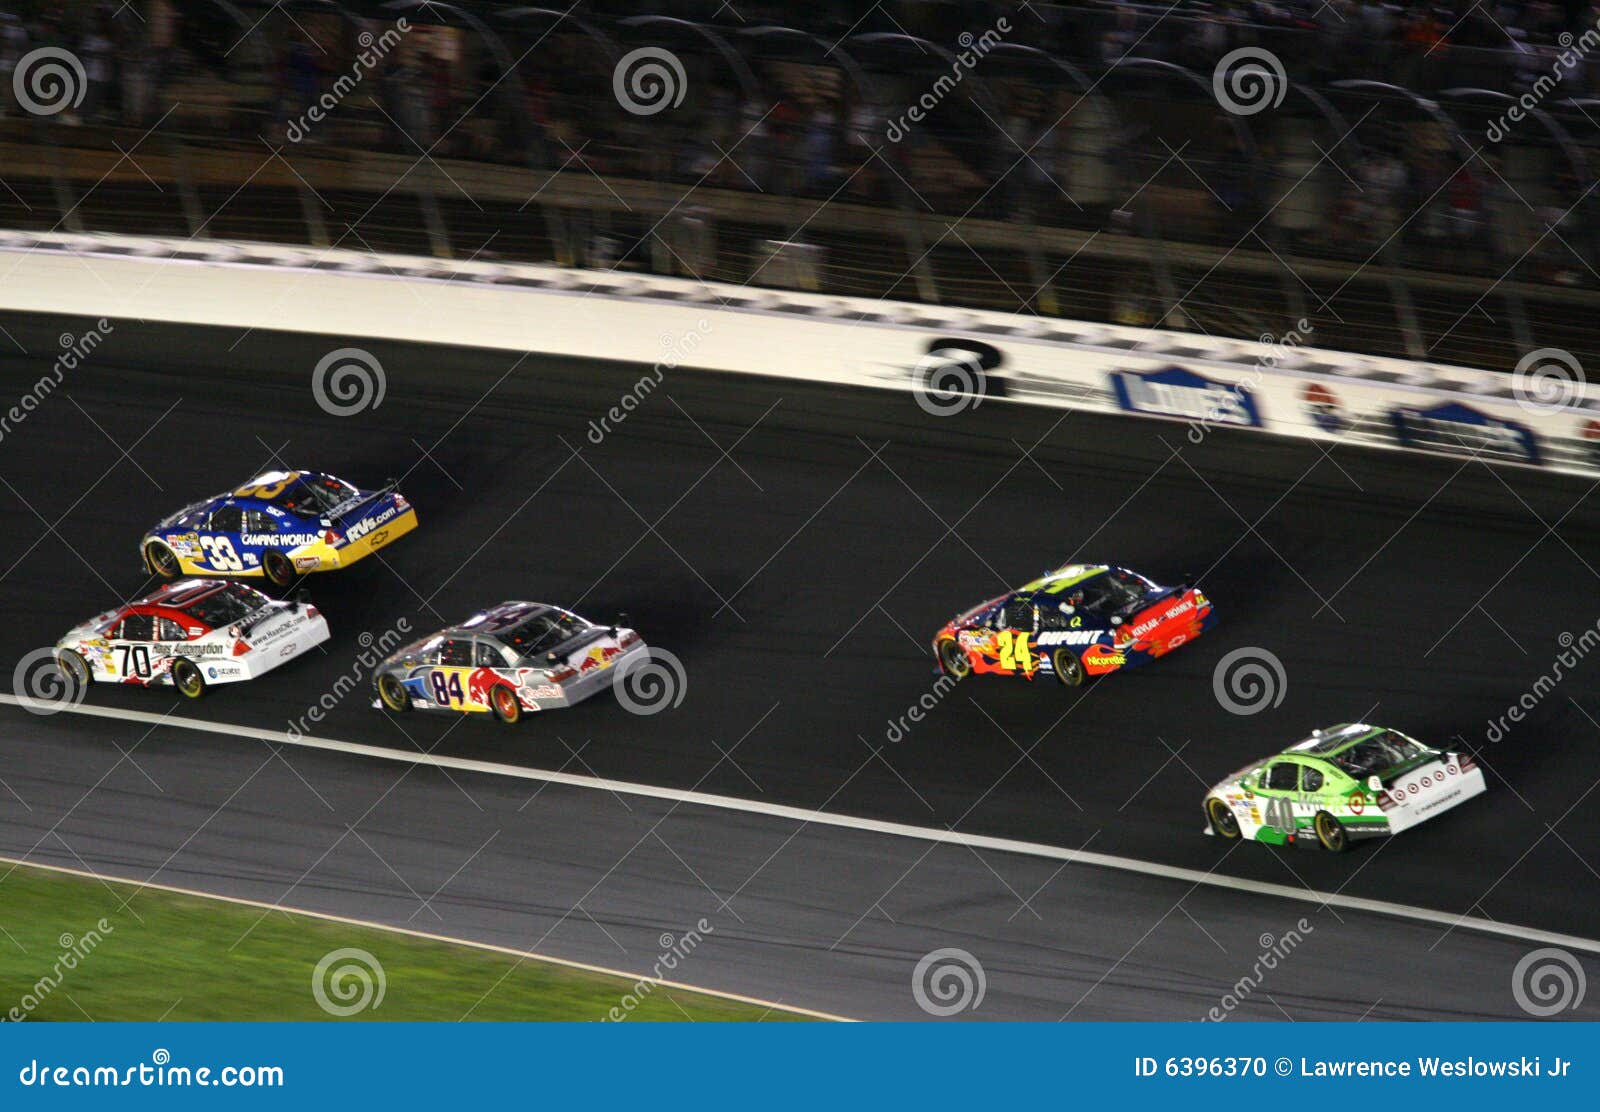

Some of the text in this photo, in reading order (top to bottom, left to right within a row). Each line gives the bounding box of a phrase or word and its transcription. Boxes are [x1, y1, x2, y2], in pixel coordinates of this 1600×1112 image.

[240, 532, 313, 547] CAMPING WORLD
[345, 506, 397, 544] RVs.com
[200, 535, 245, 572] 33
[115, 645, 152, 678] 70
[173, 642, 223, 656] Automation
[996, 630, 1034, 671] 24
[429, 669, 465, 707] 84
[1265, 796, 1297, 835] 40
